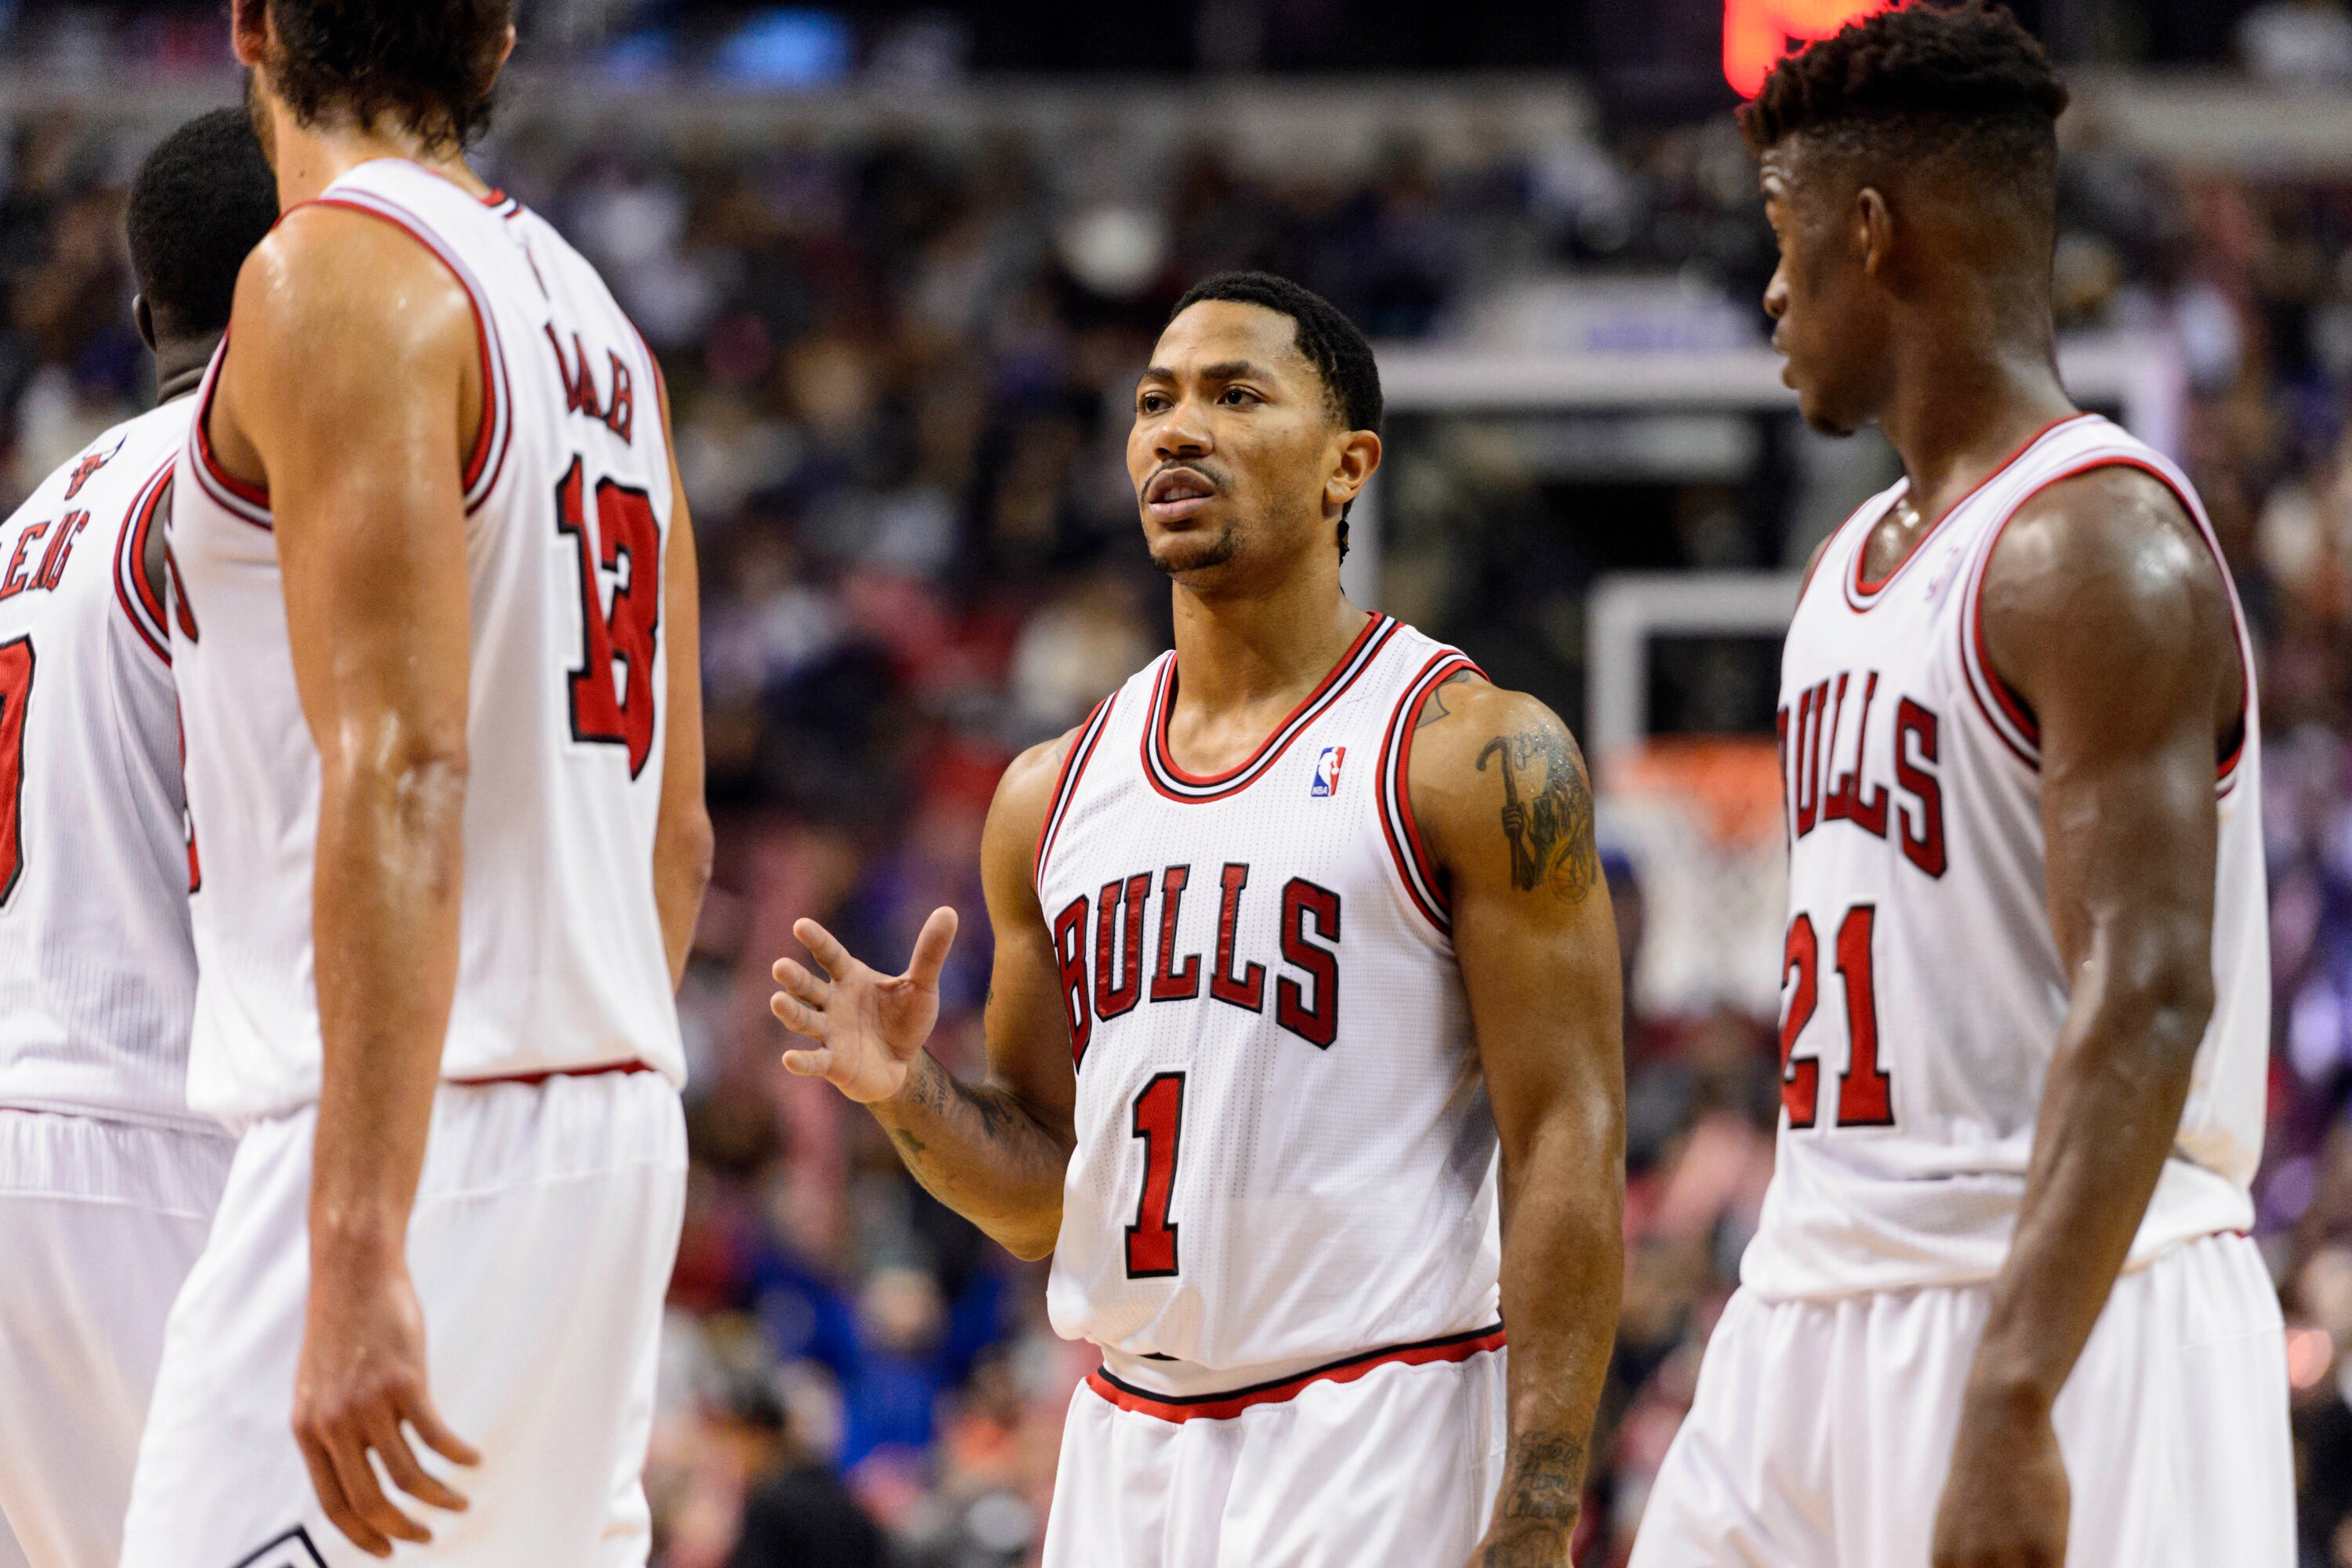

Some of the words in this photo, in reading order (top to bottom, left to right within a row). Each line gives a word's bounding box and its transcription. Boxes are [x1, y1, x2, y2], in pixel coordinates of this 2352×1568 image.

[0, 509, 91, 601] ENG
[555, 453, 660, 782] 13
[1054, 862, 1341, 1075] BULLS
[1779, 903, 1895, 1129] 21
[1125, 1070, 1186, 1279] 1
